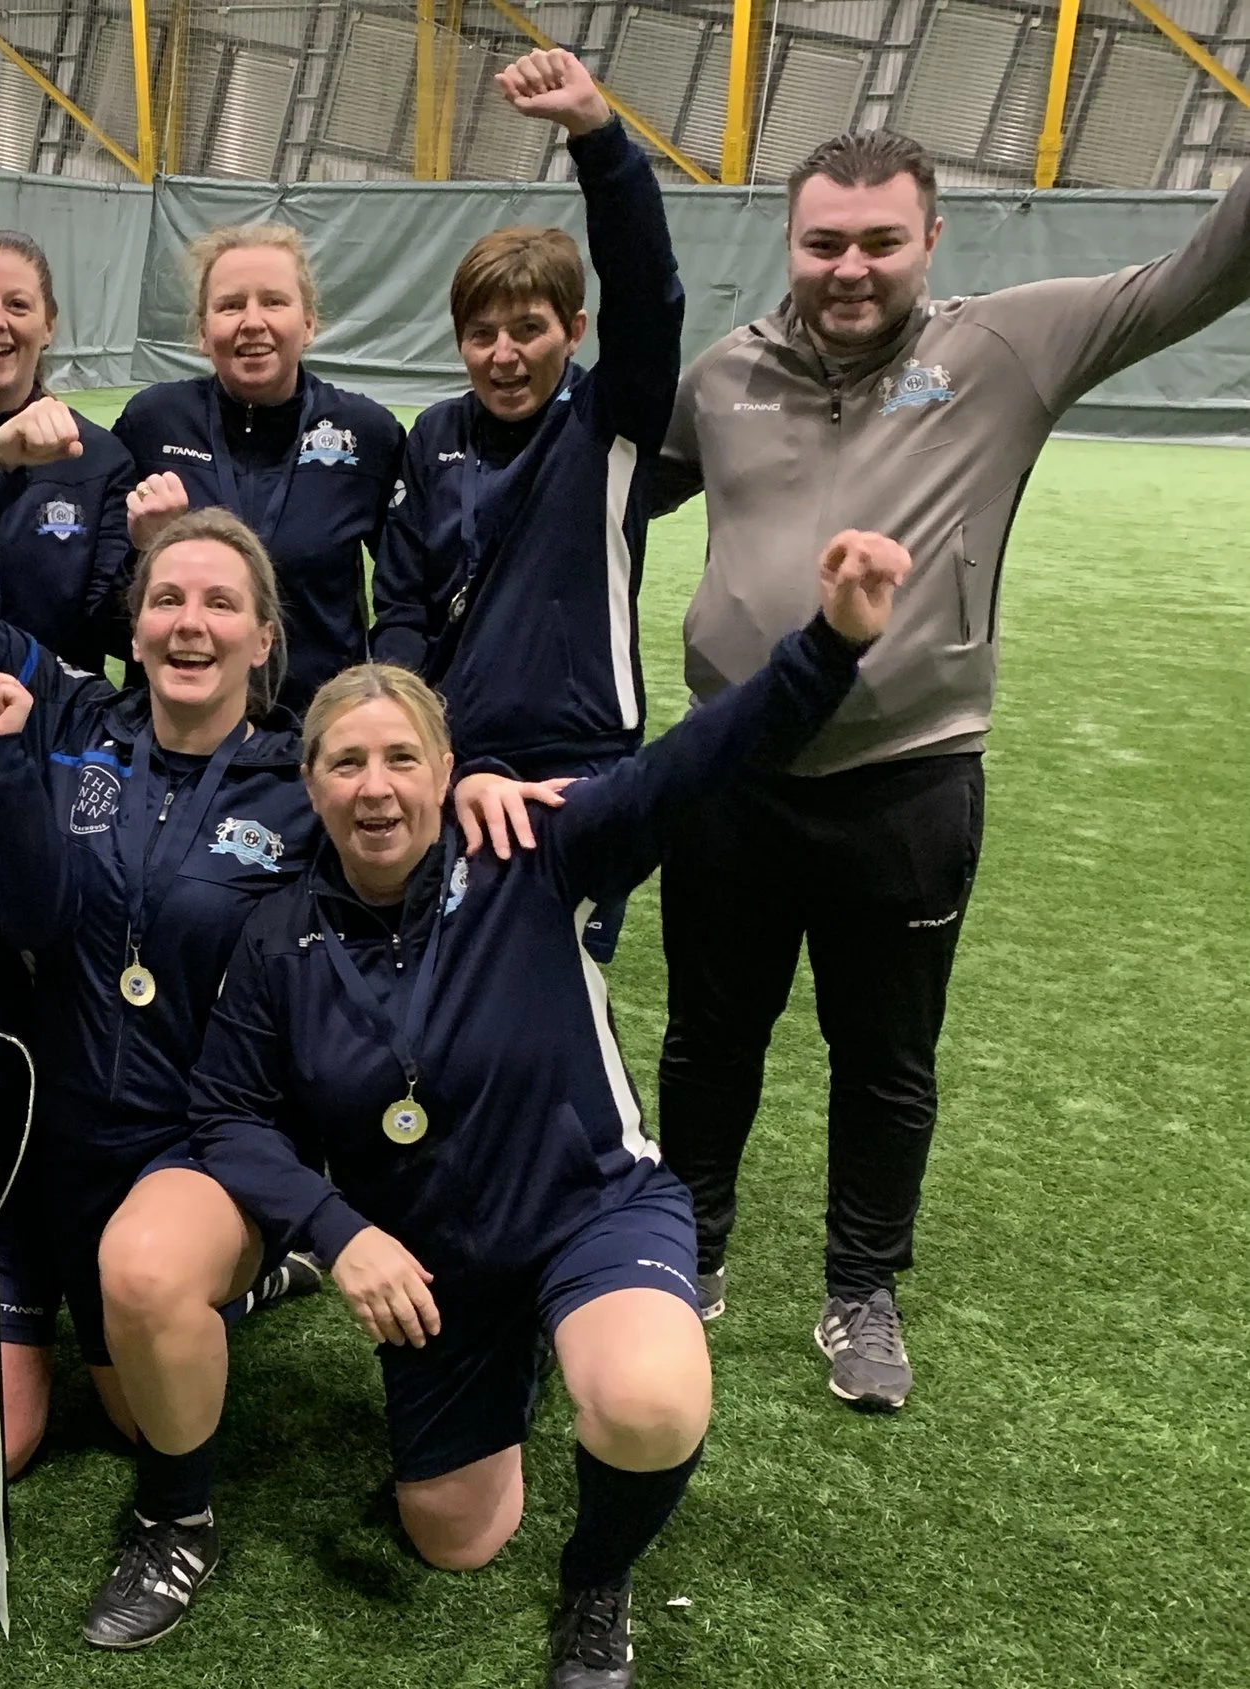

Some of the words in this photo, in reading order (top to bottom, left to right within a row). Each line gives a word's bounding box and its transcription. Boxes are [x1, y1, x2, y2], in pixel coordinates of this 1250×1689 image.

[734, 402, 781, 412] STANNO
[162, 444, 212, 462] STANNO
[82, 770, 116, 800] THE
[0, 1303, 44, 1315] TANNO
